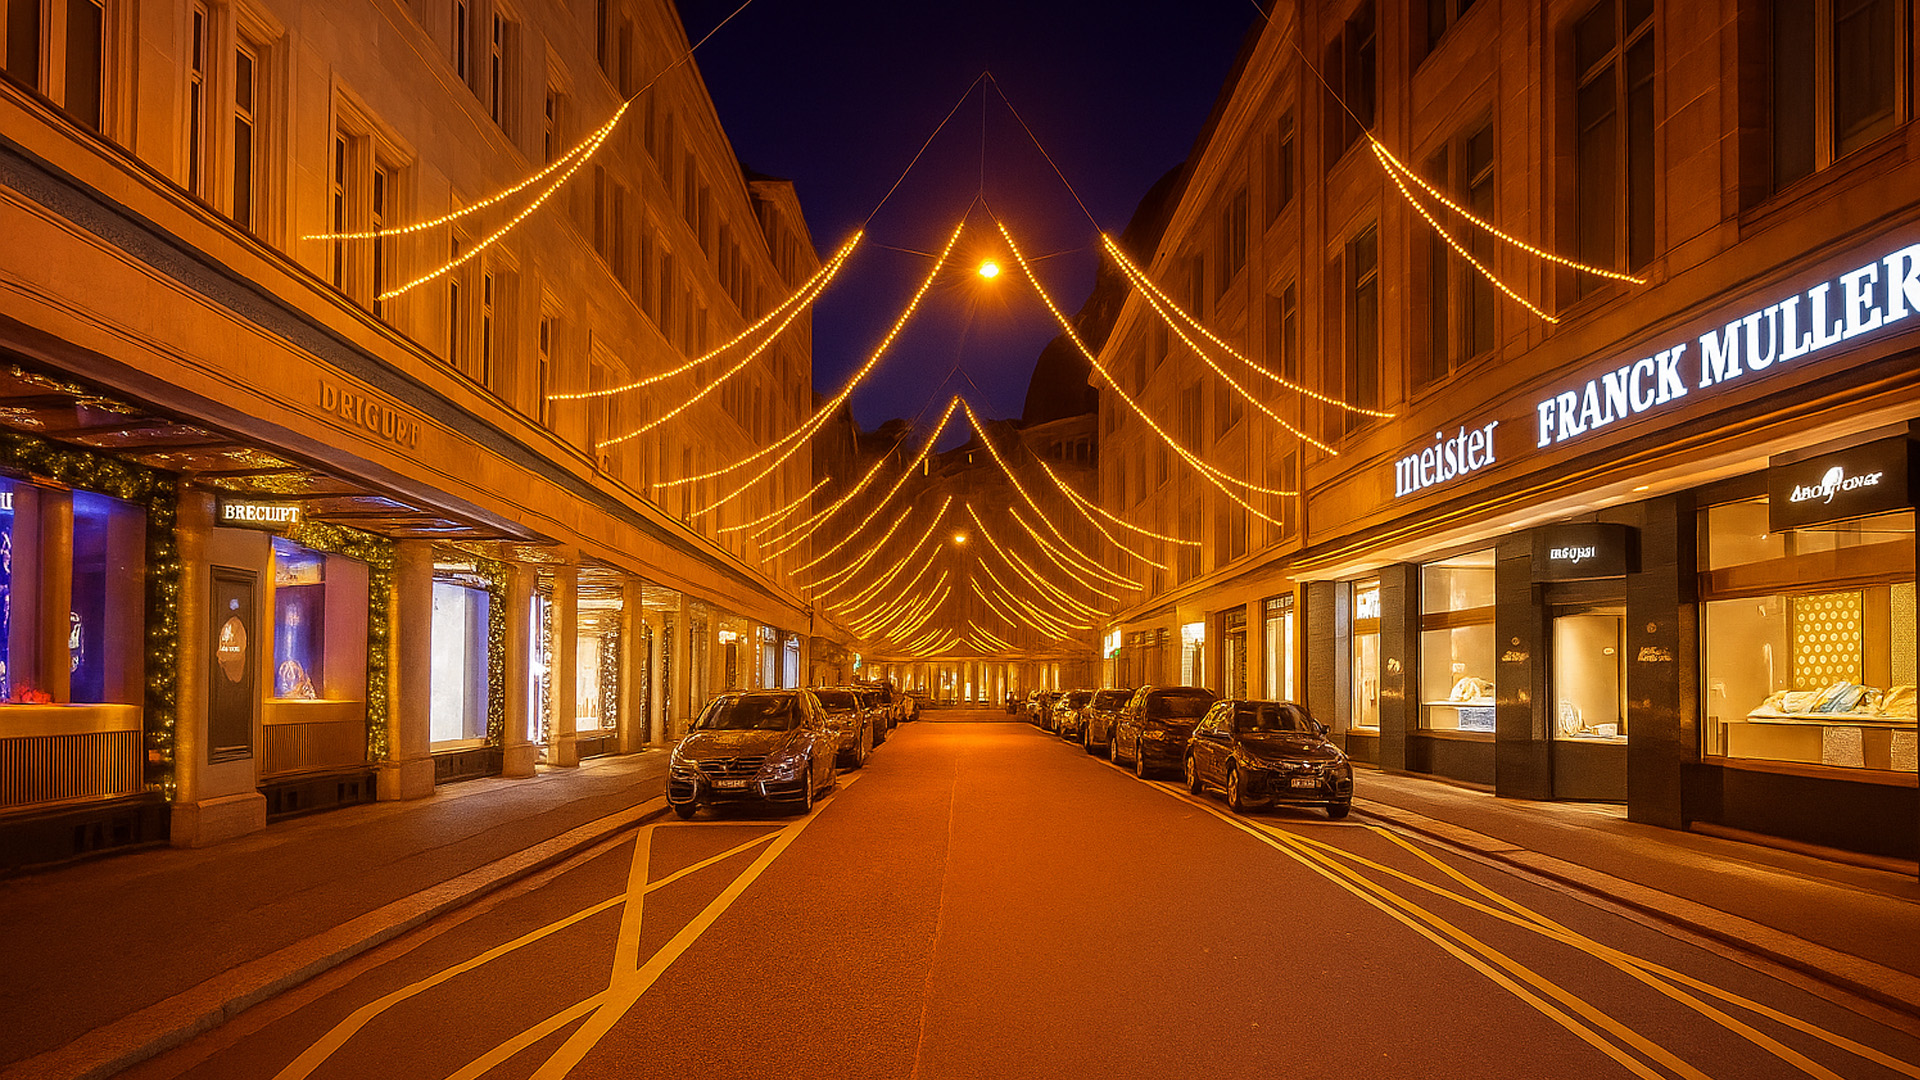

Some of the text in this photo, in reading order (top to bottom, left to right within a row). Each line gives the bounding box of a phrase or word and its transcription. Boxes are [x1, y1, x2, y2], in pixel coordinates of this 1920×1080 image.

[1537, 243, 1920, 448] FRANCK MULLER
[1394, 420, 1499, 498] meister
